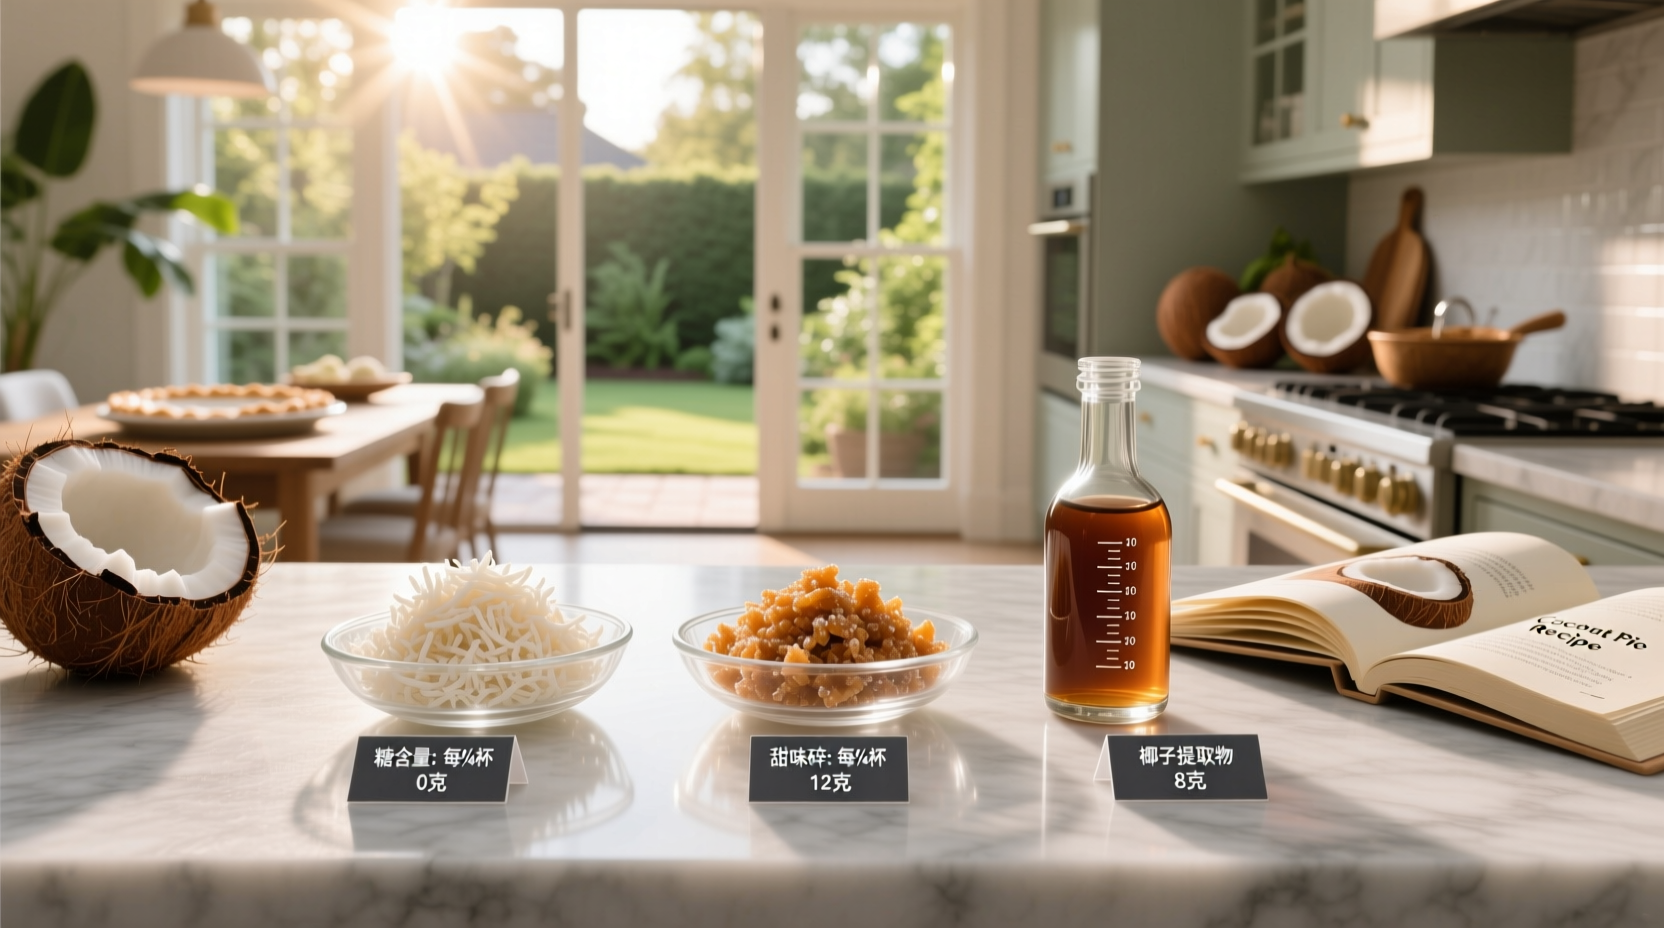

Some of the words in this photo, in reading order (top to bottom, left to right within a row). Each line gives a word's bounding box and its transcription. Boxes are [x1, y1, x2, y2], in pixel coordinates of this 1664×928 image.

[1529, 624, 1602, 650] Recipe
[416, 772, 447, 792] 0克
[810, 772, 852, 792] 12克
[1174, 770, 1207, 790] 8克
